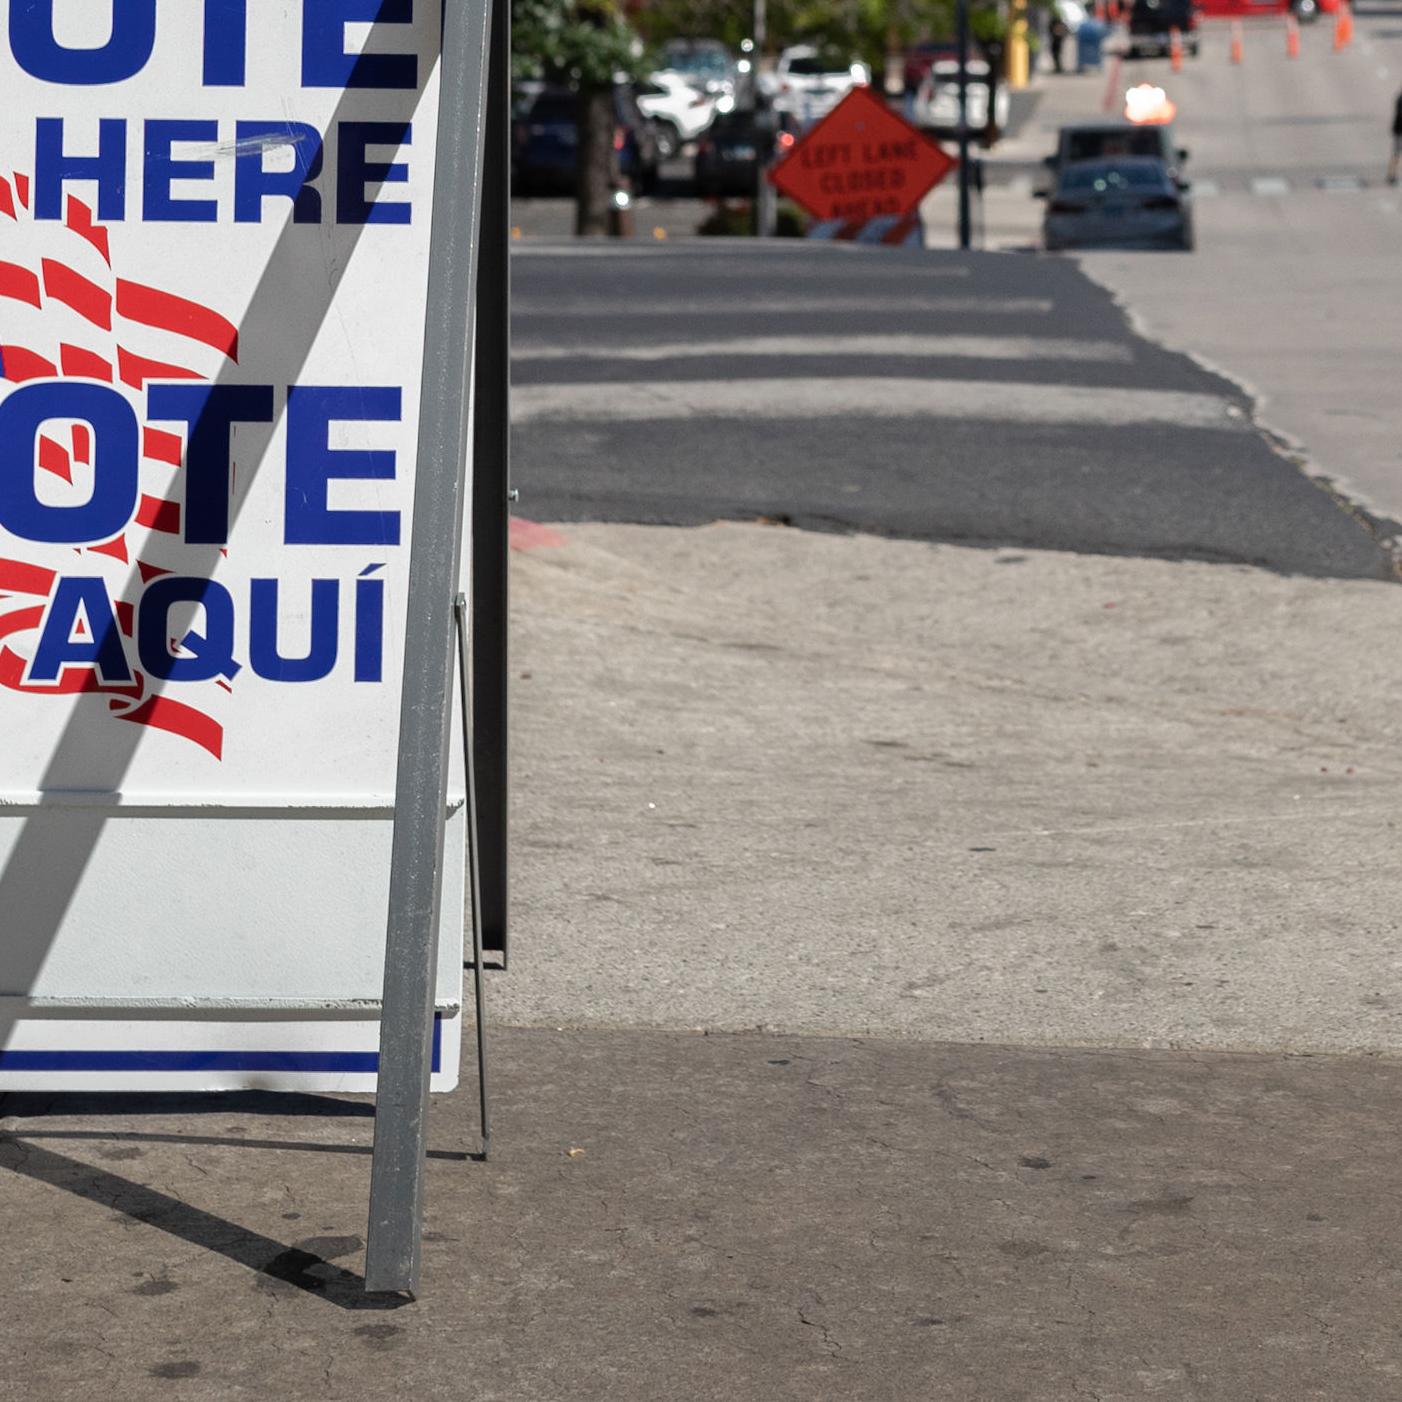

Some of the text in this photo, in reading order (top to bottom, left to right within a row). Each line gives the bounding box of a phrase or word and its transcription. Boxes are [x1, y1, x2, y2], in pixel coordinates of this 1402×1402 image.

[34, 116, 412, 225] HERE
[800, 137, 919, 169] LEFT LANE
[819, 167, 907, 195] CLOSED
[26, 562, 386, 684] AQUÍ
